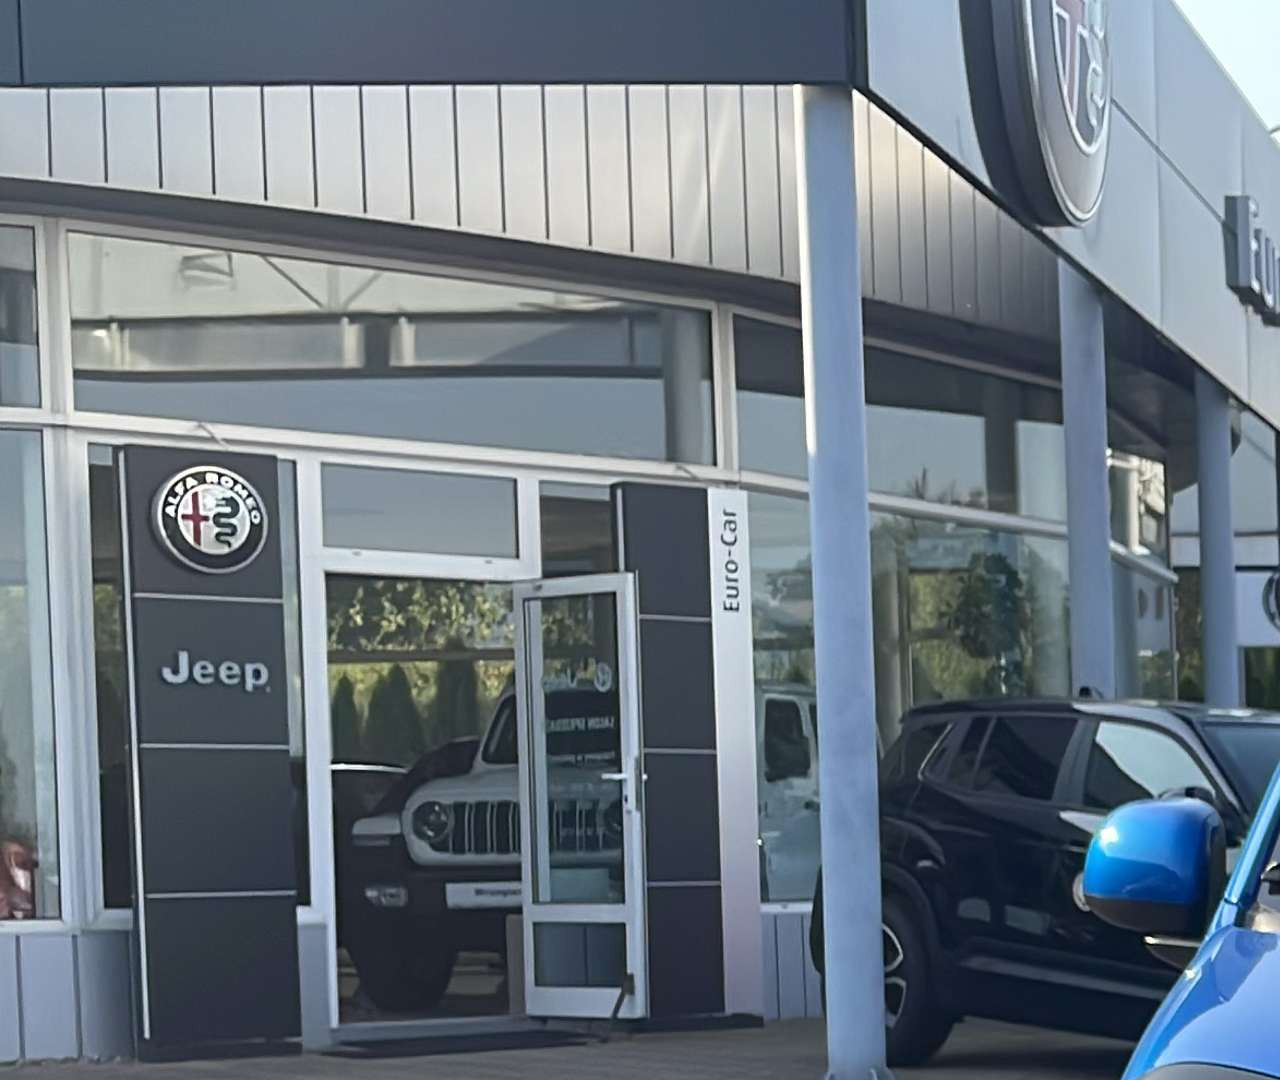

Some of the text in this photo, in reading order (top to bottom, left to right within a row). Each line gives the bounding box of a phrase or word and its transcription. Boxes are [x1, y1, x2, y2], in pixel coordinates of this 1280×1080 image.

[164, 472, 261, 525] ALFA ROMEO
[721, 508, 739, 612] Euro-Car
[161, 650, 269, 692] Jeep
